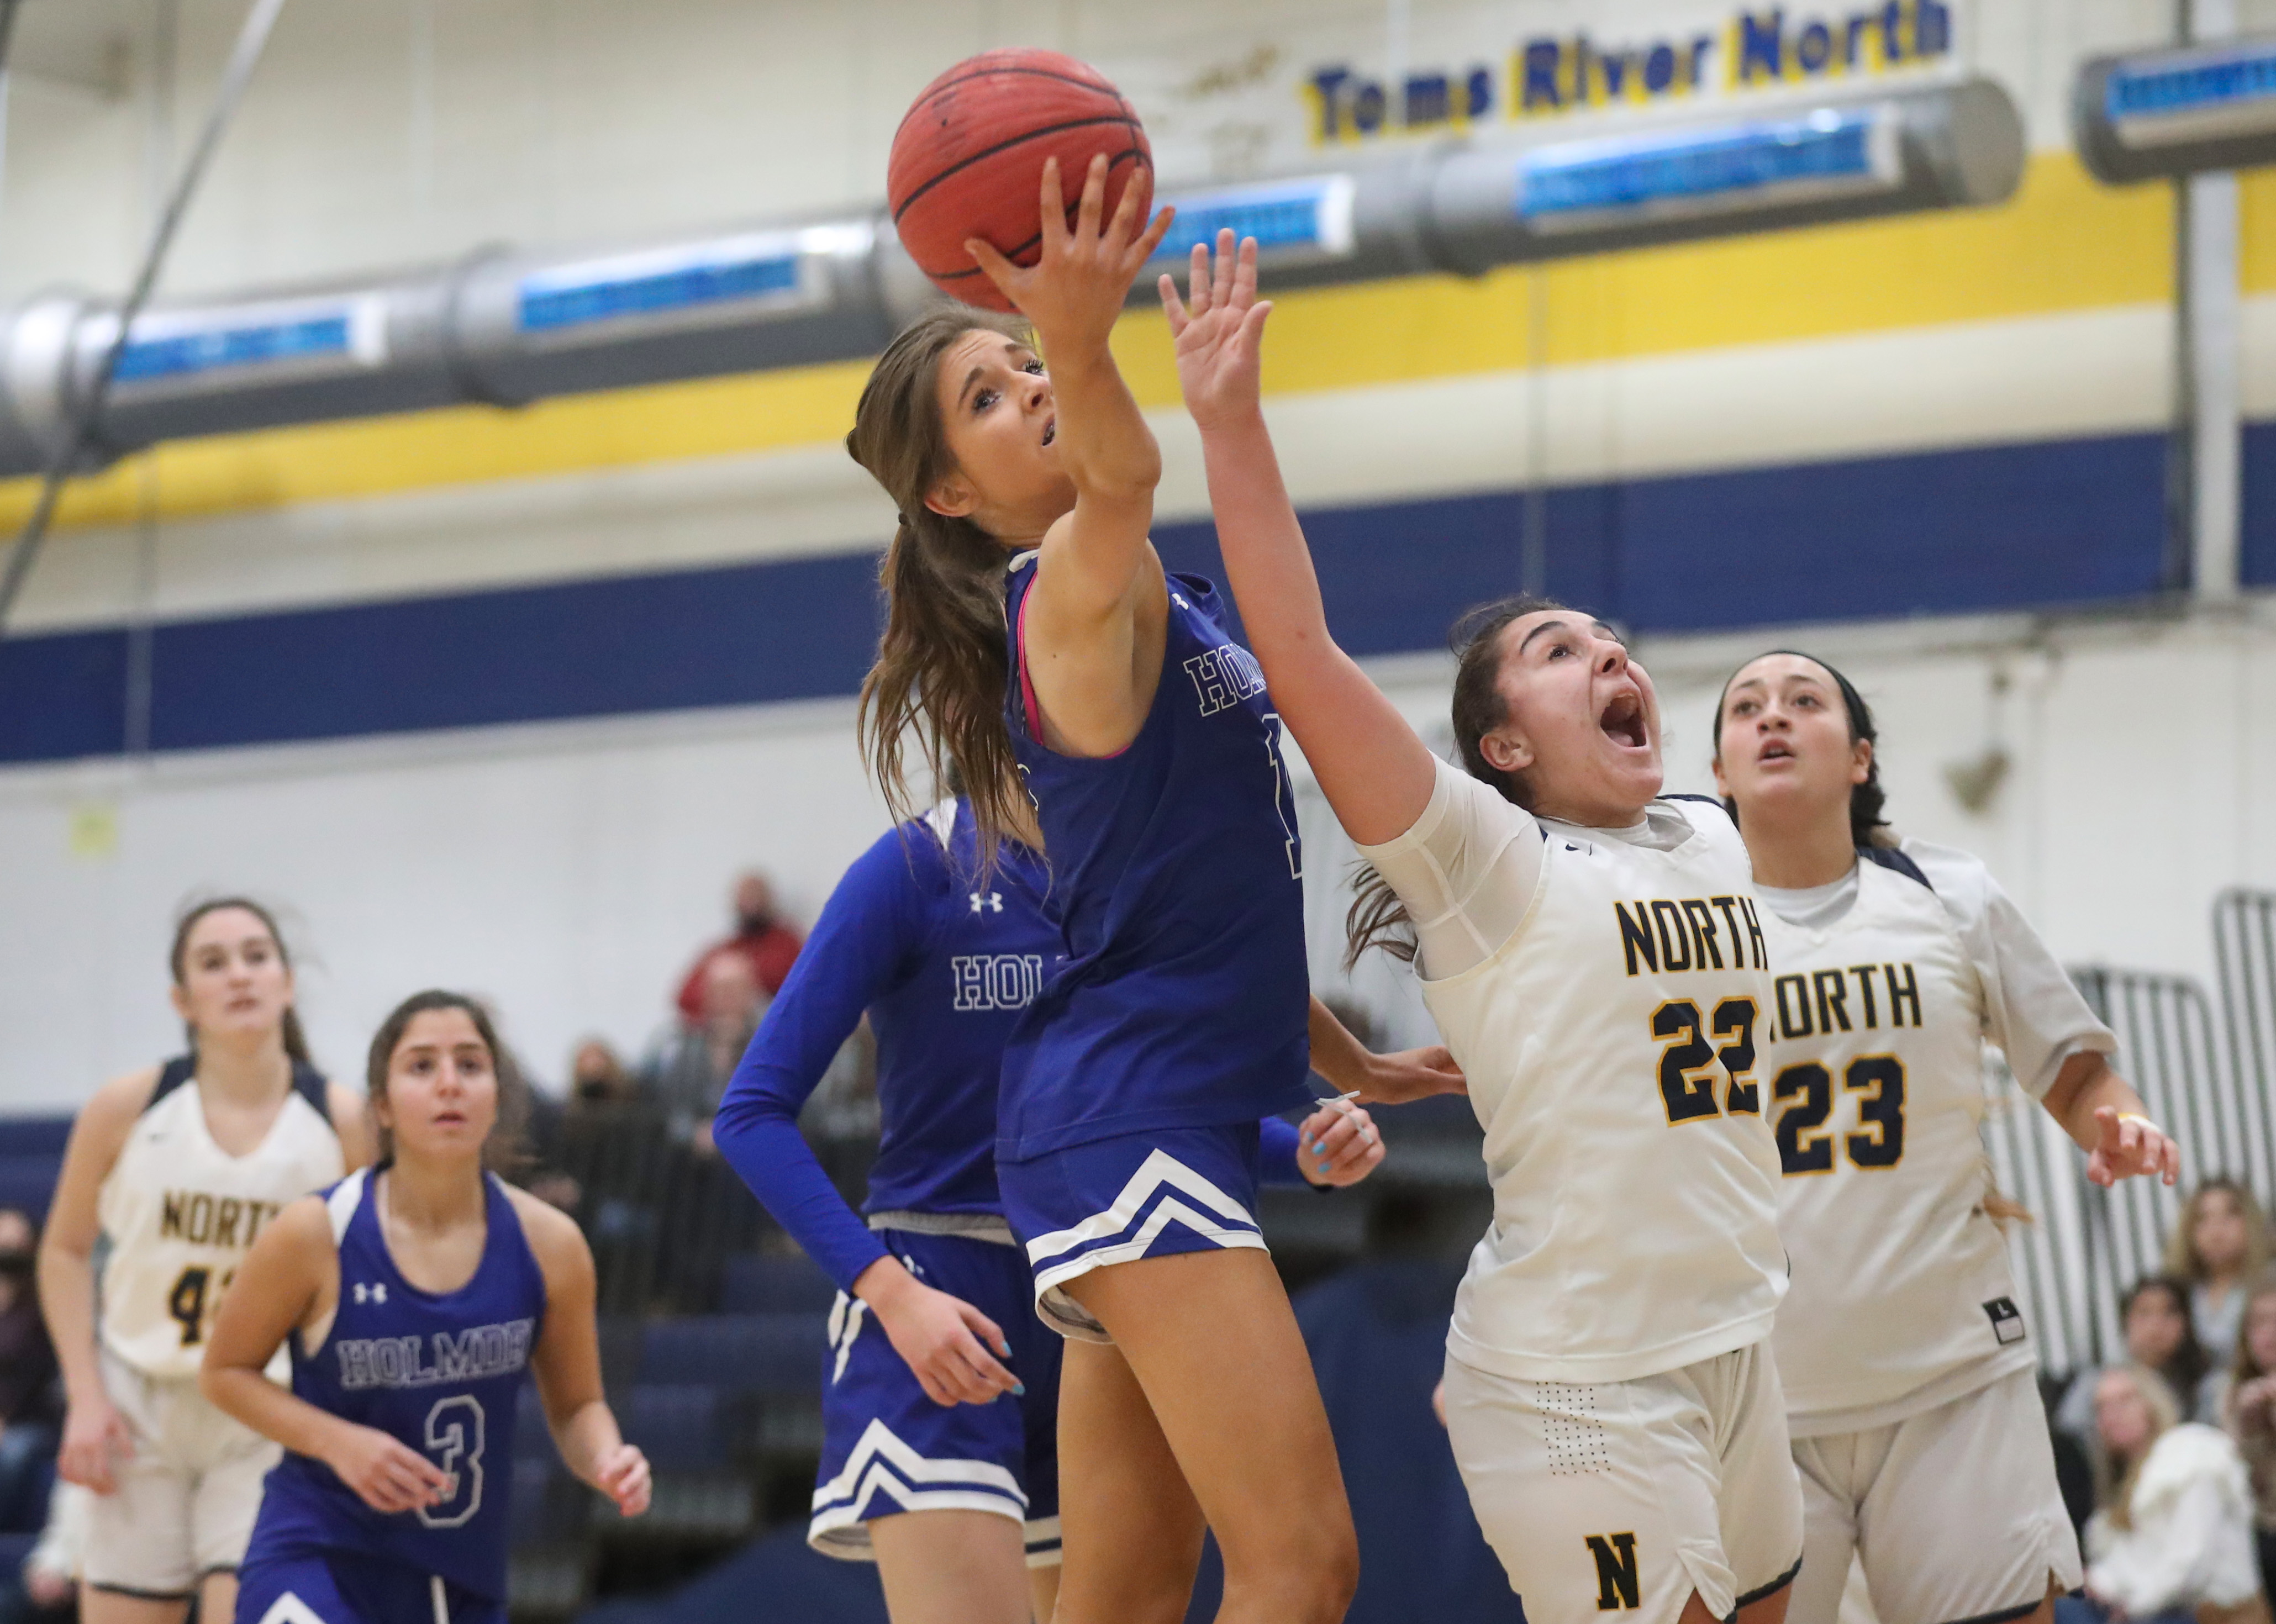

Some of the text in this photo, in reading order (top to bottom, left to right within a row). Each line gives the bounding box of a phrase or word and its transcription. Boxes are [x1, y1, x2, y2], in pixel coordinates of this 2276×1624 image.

[1720, 0, 1951, 93] North
[1183, 644, 1267, 717] HO
[1613, 895, 1768, 977] NORTH
[1770, 963, 1924, 1043] ORTH
[1648, 996, 1760, 1128] 22
[1770, 1052, 1908, 1178] 23
[160, 1188, 280, 1249] NORT
[414, 1394, 485, 1529] 3
[1583, 1530, 1642, 1612] N
